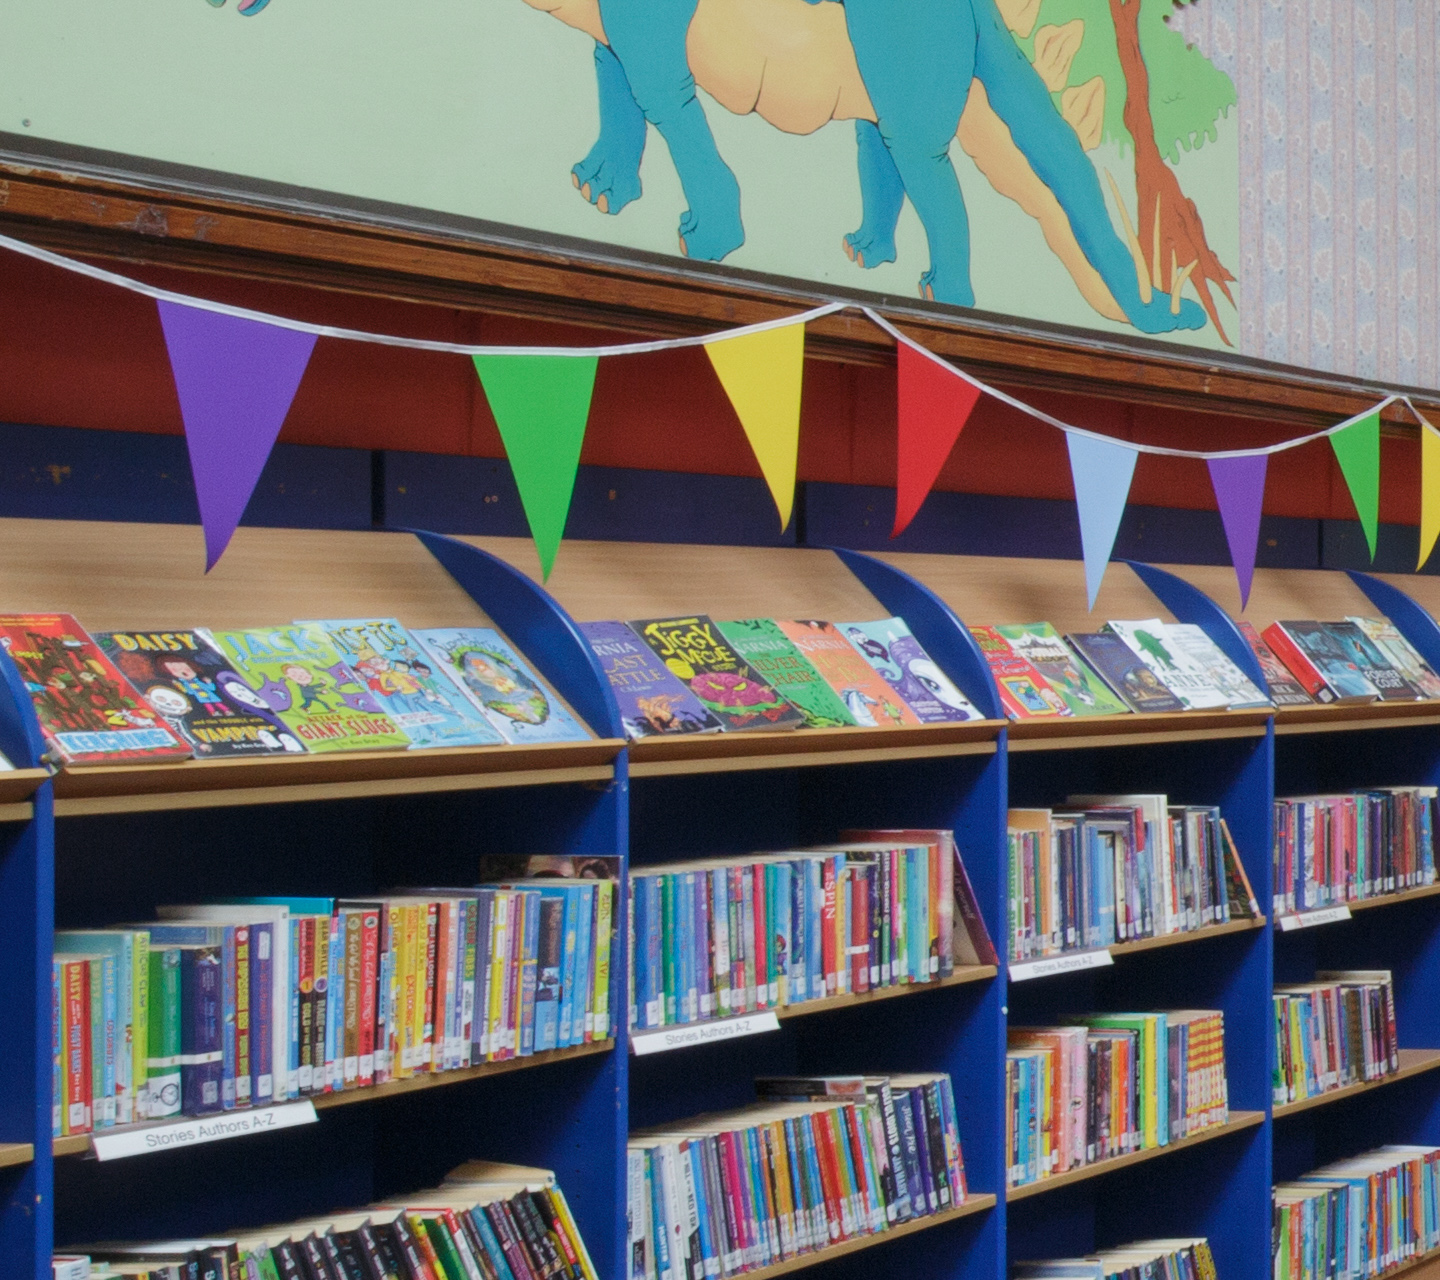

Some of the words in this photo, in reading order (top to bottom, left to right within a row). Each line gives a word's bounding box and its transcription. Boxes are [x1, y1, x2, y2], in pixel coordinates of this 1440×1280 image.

[114, 633, 198, 652] DAISY
[225, 629, 324, 672] JACK
[596, 642, 638, 656] RNIA
[297, 723, 348, 740] GIANT
[351, 718, 397, 737] SLUGS
[1032, 963, 1052, 975] Stories
[1054, 958, 1078, 970] Authors
[1080, 956, 1094, 966] A-Z
[70, 965, 80, 1000] DAISY
[665, 1031, 696, 1046] Stories
[701, 1025, 733, 1039] Authors
[735, 1021, 751, 1032] A-Z
[146, 1127, 196, 1148] Stories
[199, 1118, 248, 1140] Authors
[252, 1112, 276, 1128] A-Z
